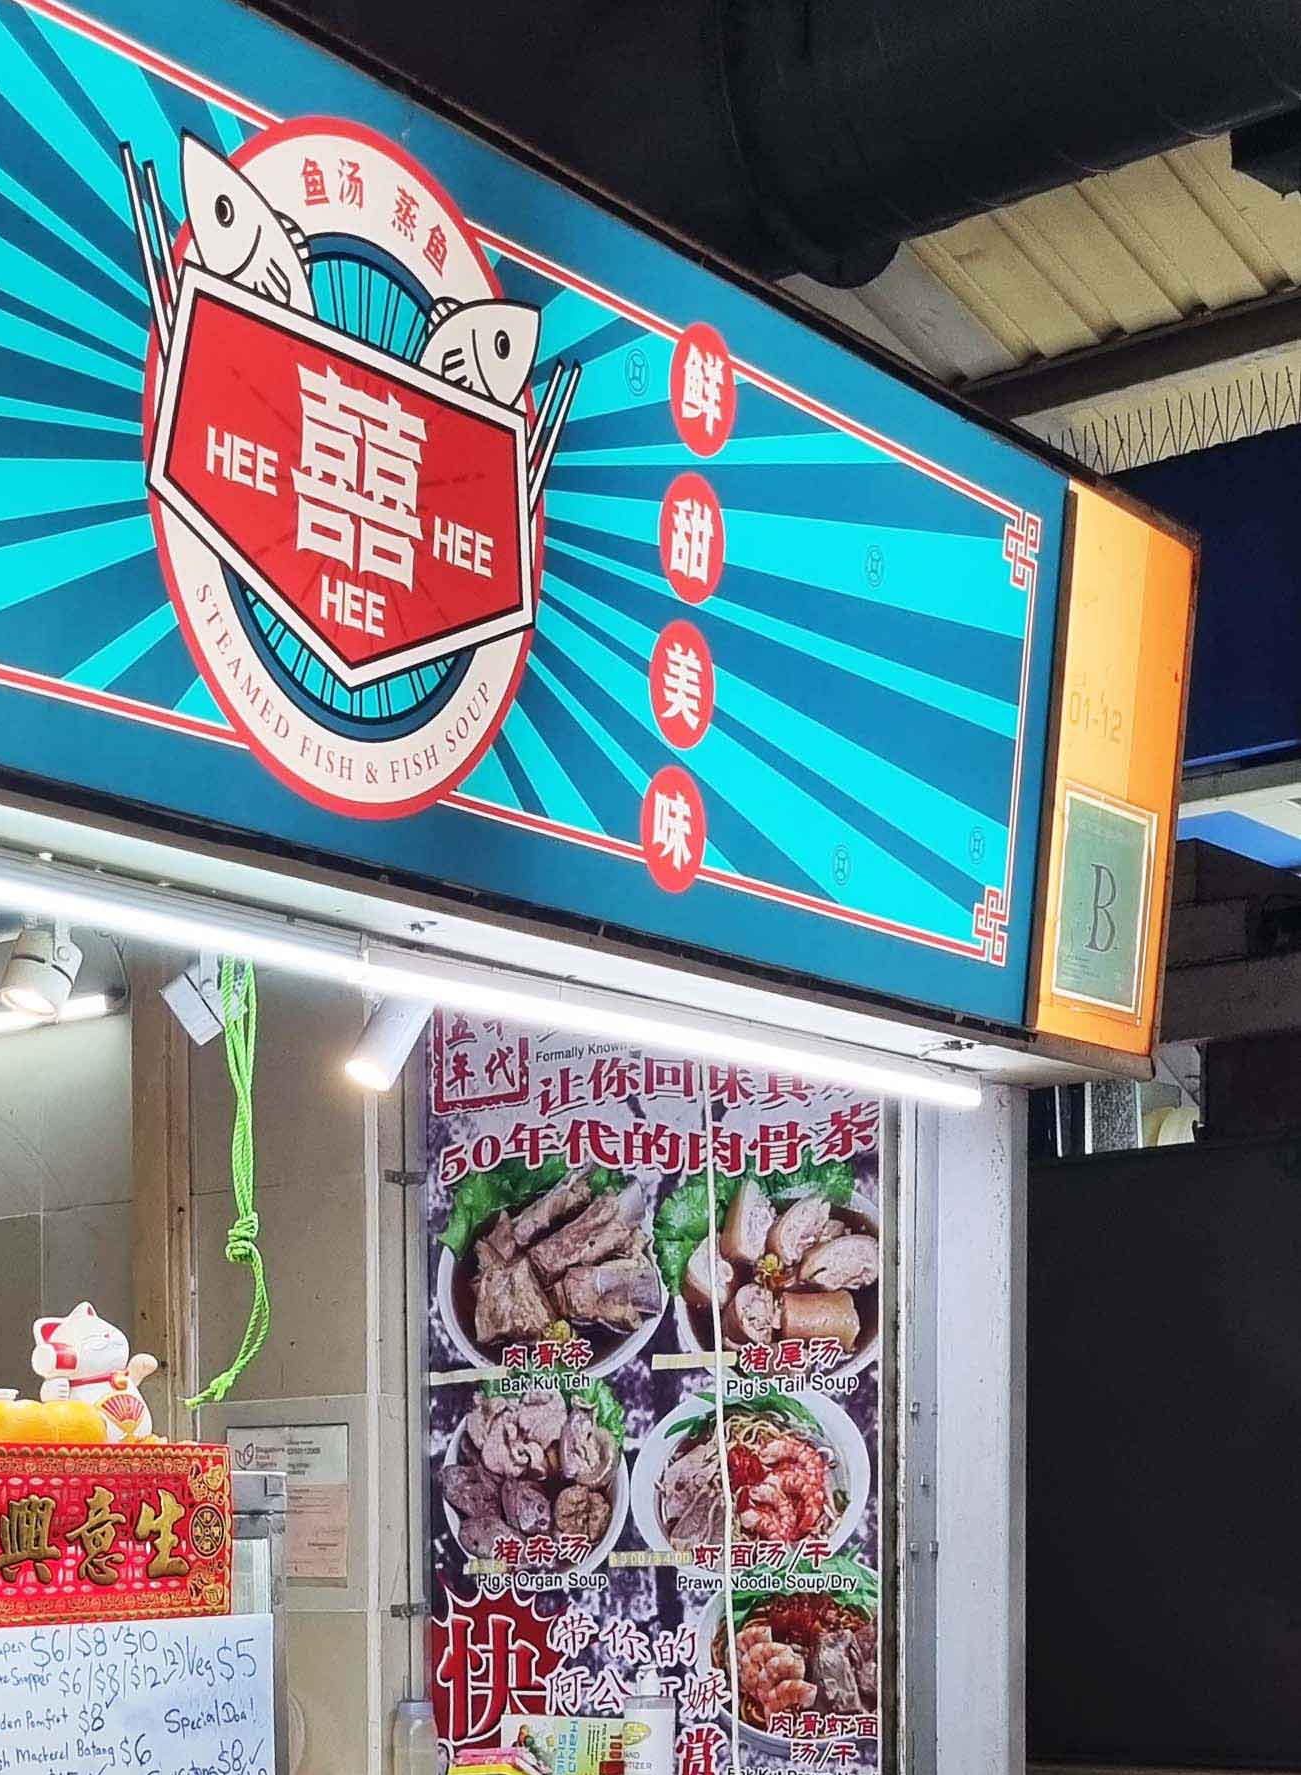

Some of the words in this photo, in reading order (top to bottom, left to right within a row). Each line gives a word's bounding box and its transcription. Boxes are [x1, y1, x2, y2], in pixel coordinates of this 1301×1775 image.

[301, 156, 365, 209] 鱼汤
[391, 187, 450, 276] 蒸鱼
[207, 426, 278, 497] HEE
[433, 514, 494, 576] HEE
[319, 575, 387, 638] HEE
[195, 583, 291, 740] STEAMED
[299, 734, 354, 782] FISH
[365, 760, 379, 784] &
[389, 743, 441, 784] FISH
[444, 681, 492, 752] SOUP
[1084, 863, 1117, 952] B
[535, 1041, 586, 1063] Formally
[439, 1102, 880, 1184] 50年代的肉骨茶
[503, 1339, 593, 1371] 肉骨茶
[740, 1337, 843, 1372] 猪尾汤
[501, 1377, 528, 1393] Bak
[533, 1375, 559, 1391] Kut
[562, 1374, 591, 1390] Teh
[726, 1378, 769, 1400] Pig's
[771, 1375, 805, 1393] Tail
[813, 1374, 858, 1394] Soup
[493, 1535, 592, 1566] 猪杂汤
[477, 1572, 512, 1590] Pig's
[517, 1571, 563, 1589] Organ
[568, 1572, 607, 1589] Soup
[678, 1576, 723, 1591] Prawn
[731, 1575, 780, 1590] Noodle
[786, 1575, 858, 1594] Soup/Dry
[552, 1612, 697, 1668] 带你的
[186, 1635, 216, 1687] Veg
[216, 1637, 257, 1681] $5
[440, 1616, 546, 1742] 快
[78, 1703, 105, 1737] $8
[164, 1699, 221, 1739] Special
[77, 1739, 115, 1766] Batang
[120, 1733, 152, 1767] $6
[792, 1742, 857, 1770] 汤/干
